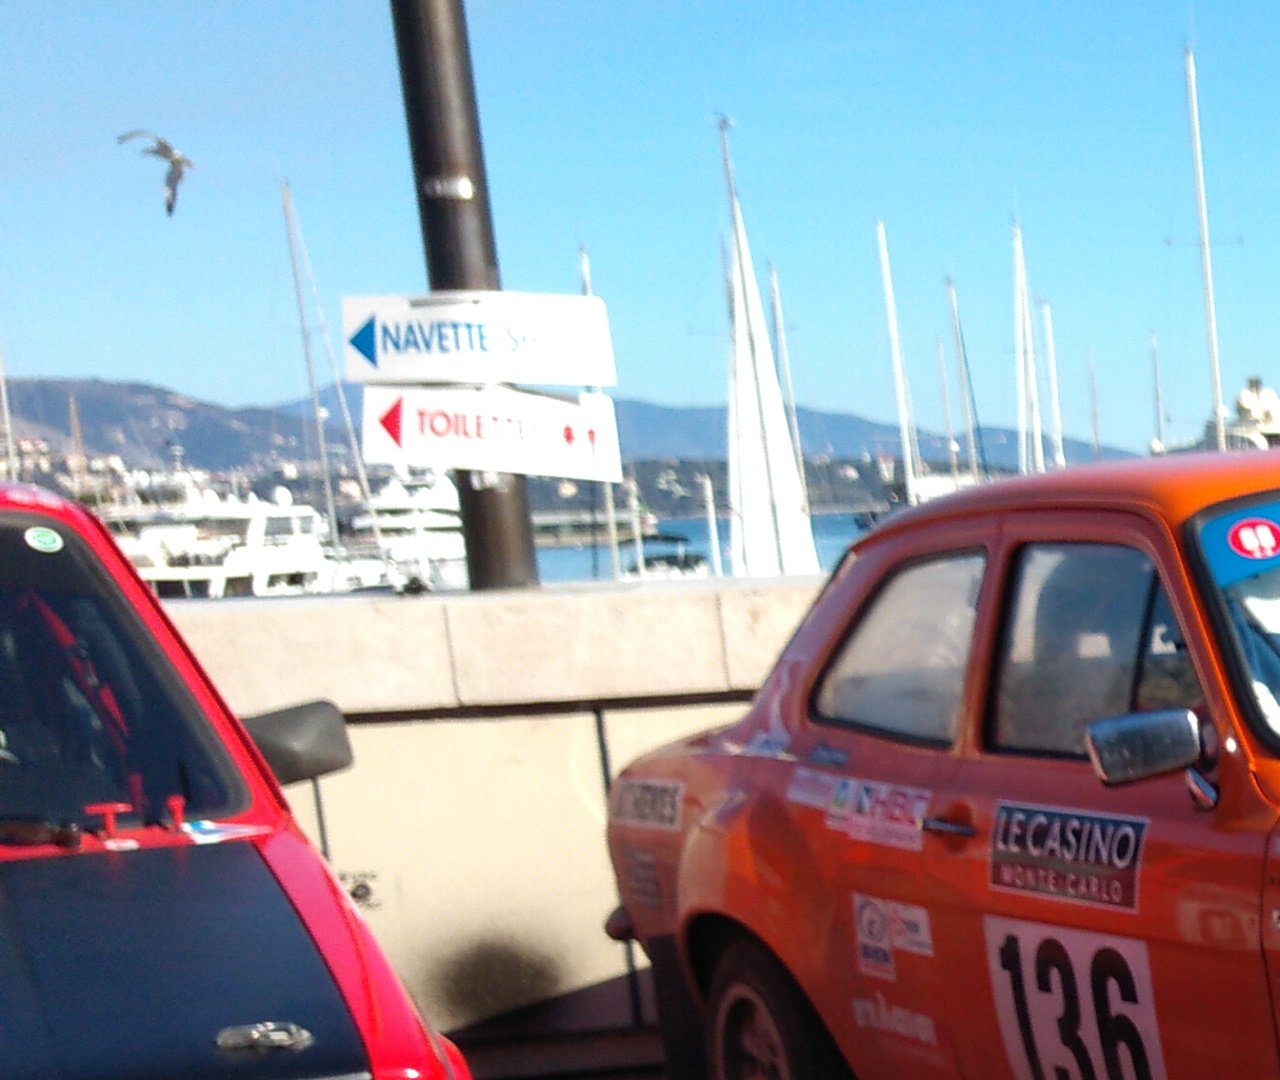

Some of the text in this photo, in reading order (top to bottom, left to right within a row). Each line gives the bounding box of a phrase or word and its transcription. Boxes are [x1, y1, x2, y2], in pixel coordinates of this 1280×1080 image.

[381, 319, 490, 354] NAVETTE
[997, 805, 1136, 869] LE CASINO
